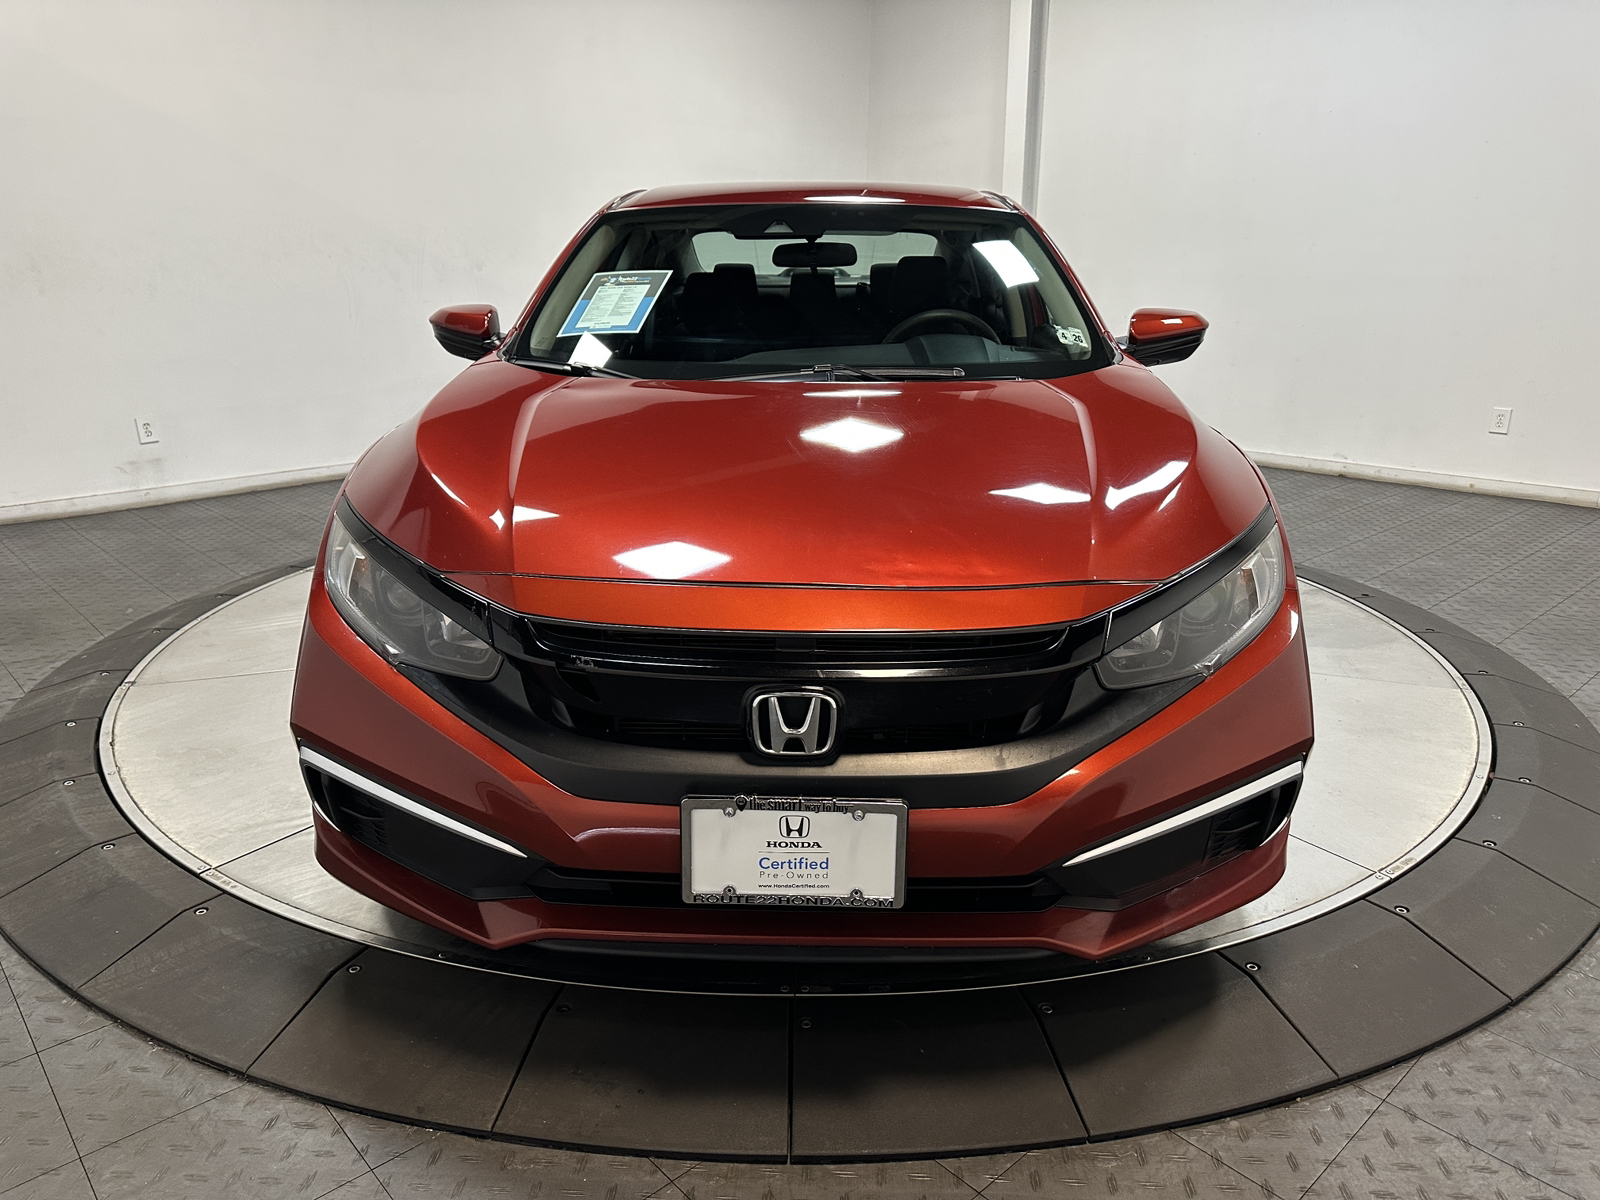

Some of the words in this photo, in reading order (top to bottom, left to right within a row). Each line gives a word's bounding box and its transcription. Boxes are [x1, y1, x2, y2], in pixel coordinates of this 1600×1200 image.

[1072, 334, 1083, 343] 26
[749, 796, 766, 810] the
[767, 796, 803, 811] smart
[804, 803, 820, 813] way
[822, 801, 831, 812] to
[832, 798, 849, 814] buy
[765, 840, 823, 849] HONDA
[758, 856, 829, 870] Certified
[759, 870, 829, 879] Pre-Owned
[693, 894, 894, 908] ROUTE22HONDA.COM
